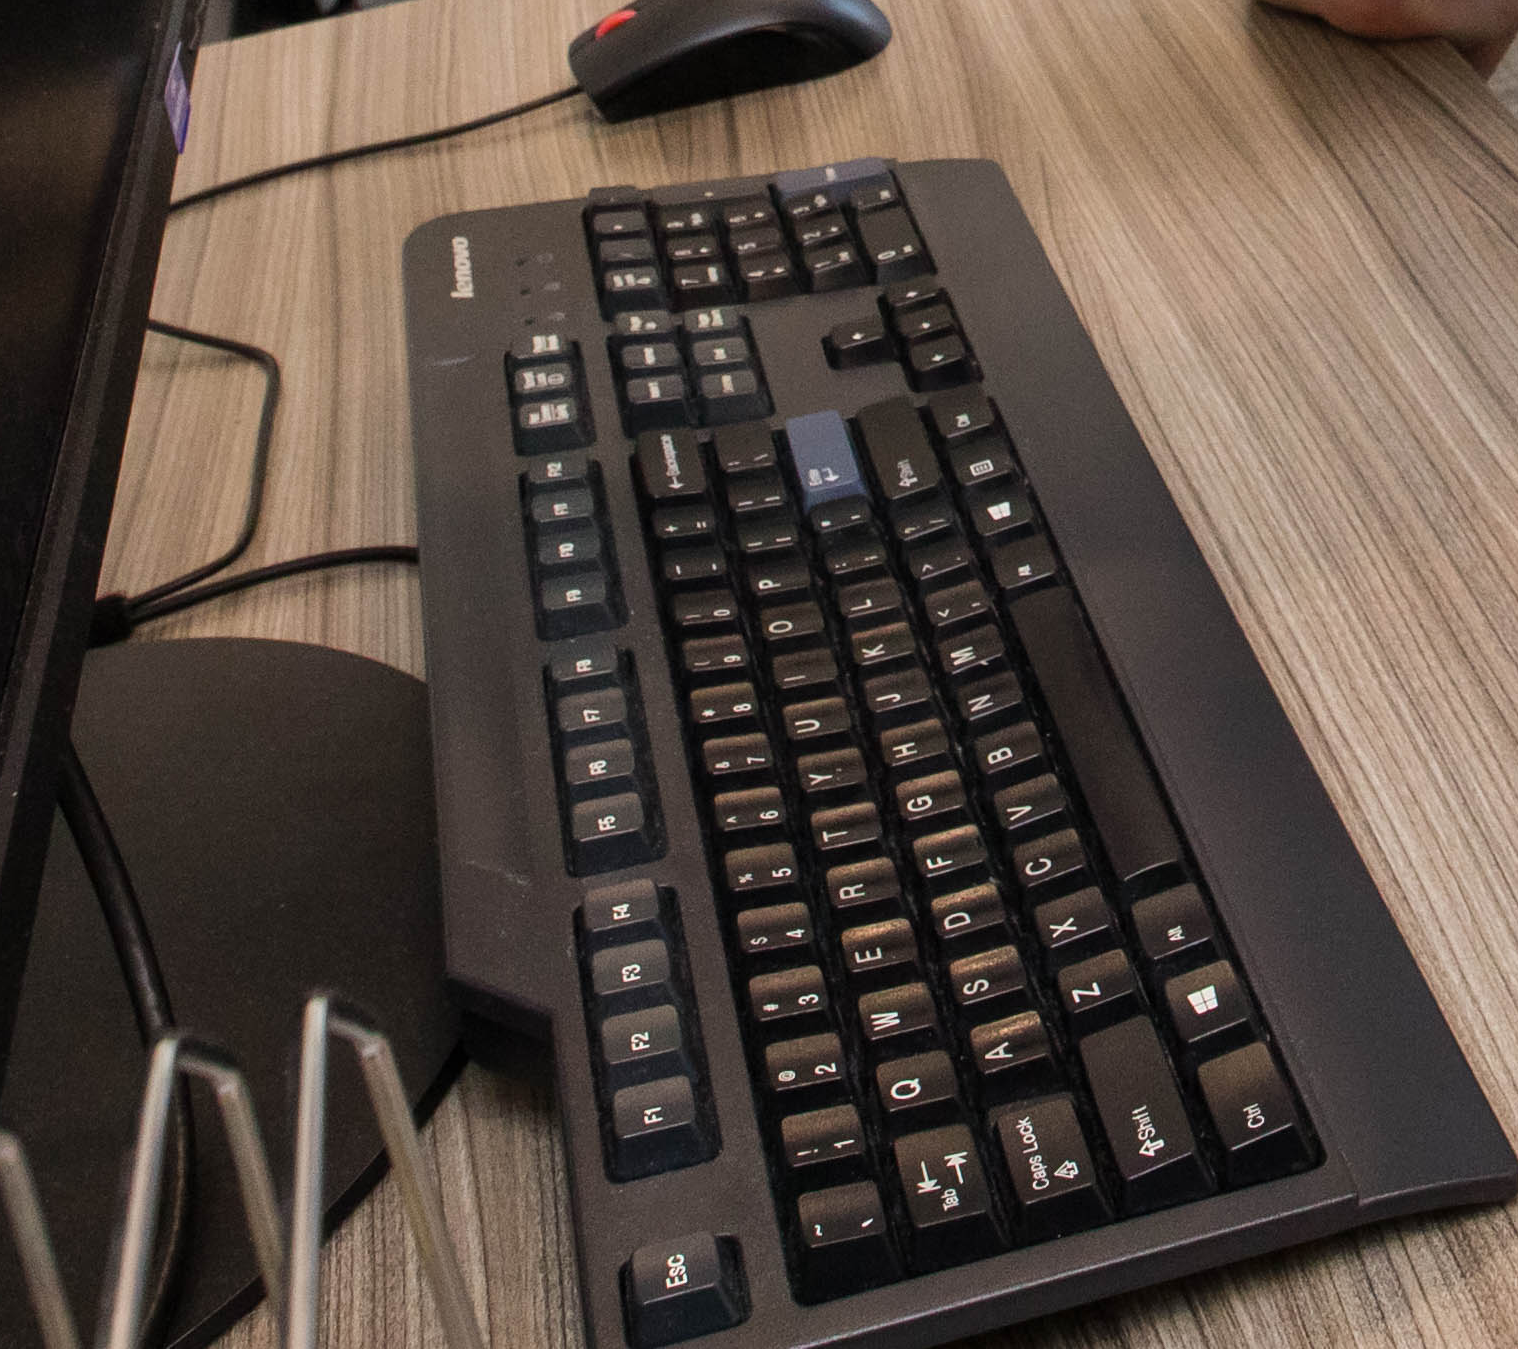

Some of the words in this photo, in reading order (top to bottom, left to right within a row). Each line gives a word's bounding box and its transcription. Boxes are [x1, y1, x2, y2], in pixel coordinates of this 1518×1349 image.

[450, 236, 474, 298] lenovo
[759, 580, 780, 589] P
[862, 644, 885, 657] K
[951, 647, 975, 665] M
[876, 694, 900, 702] J
[969, 695, 993, 715] N
[583, 710, 600, 722] F7
[733, 704, 751, 712] 8
[795, 720, 820, 733] U
[893, 743, 917, 758] H
[988, 748, 1012, 764] B
[809, 775, 832, 785] Y
[907, 796, 932, 811] G
[760, 811, 778, 819] 6
[1007, 806, 1035, 823] V
[598, 816, 615, 831] F5
[823, 832, 850, 845] T
[772, 868, 791, 877] 5
[927, 857, 952, 873] F
[1026, 859, 1051, 875] C
[840, 884, 865, 899] R
[613, 904, 630, 919] F4
[944, 912, 970, 929] D
[1050, 918, 1079, 939] X
[786, 929, 804, 937] 4
[1167, 924, 1186, 944] Alt
[855, 948, 881, 963] E
[622, 964, 640, 982] F3
[963, 980, 992, 998] S
[1072, 983, 1100, 1002] Z
[799, 994, 818, 1004] 3
[871, 1012, 900, 1030] W
[631, 1032, 650, 1050] F2
[985, 1042, 1013, 1059] A
[815, 1063, 836, 1074] 2
[891, 1079, 921, 1099] Q
[644, 1107, 663, 1124] F1
[1131, 1104, 1157, 1141] Shift
[1242, 1102, 1265, 1130] Ctrl
[1015, 1115, 1039, 1155] Lock
[1027, 1154, 1050, 1192] Caps
[940, 1187, 961, 1212] Tab
[666, 1254, 688, 1290] ESC
